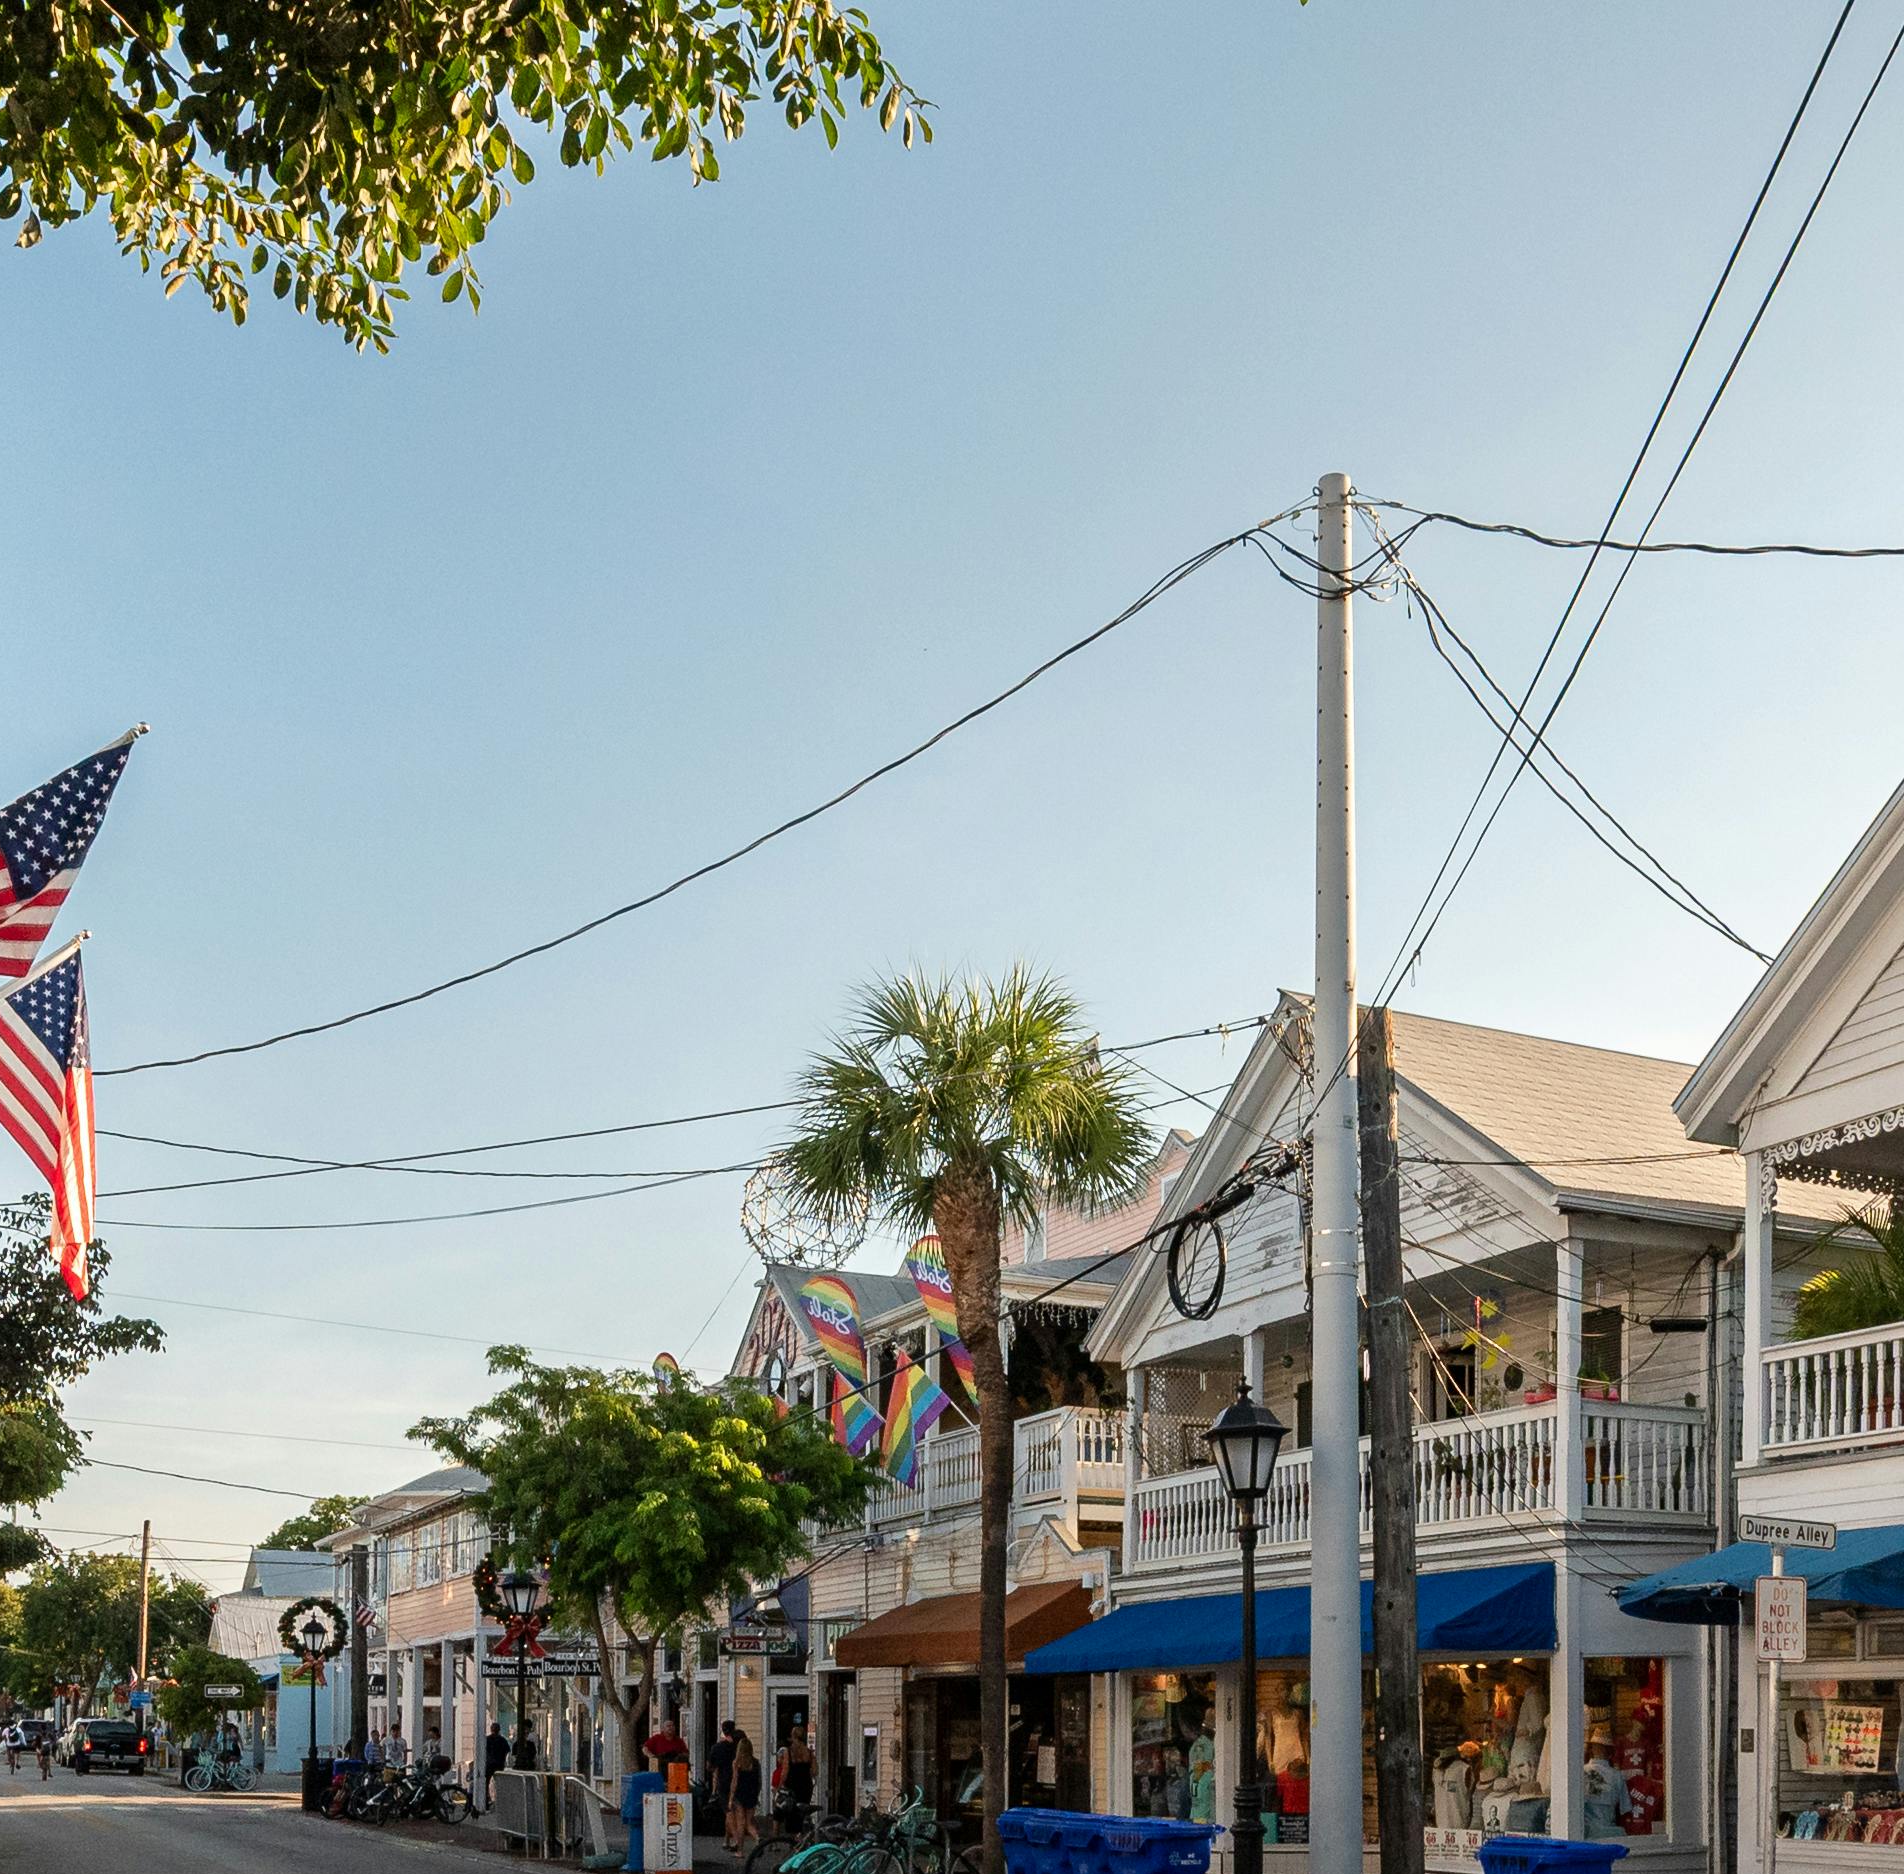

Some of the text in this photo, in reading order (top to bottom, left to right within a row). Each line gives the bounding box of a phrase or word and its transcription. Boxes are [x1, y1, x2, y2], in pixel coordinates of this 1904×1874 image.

[1746, 1520, 1829, 1547] Dupree Alley
[1773, 1587, 1788, 1601] DO
[1770, 1604, 1791, 1617] NOT
[1762, 1620, 1799, 1634] BLOCK
[1762, 1637, 1798, 1651] ALLEY
[482, 1664, 516, 1675] Bourbon
[544, 1661, 581, 1673] Bourbon
